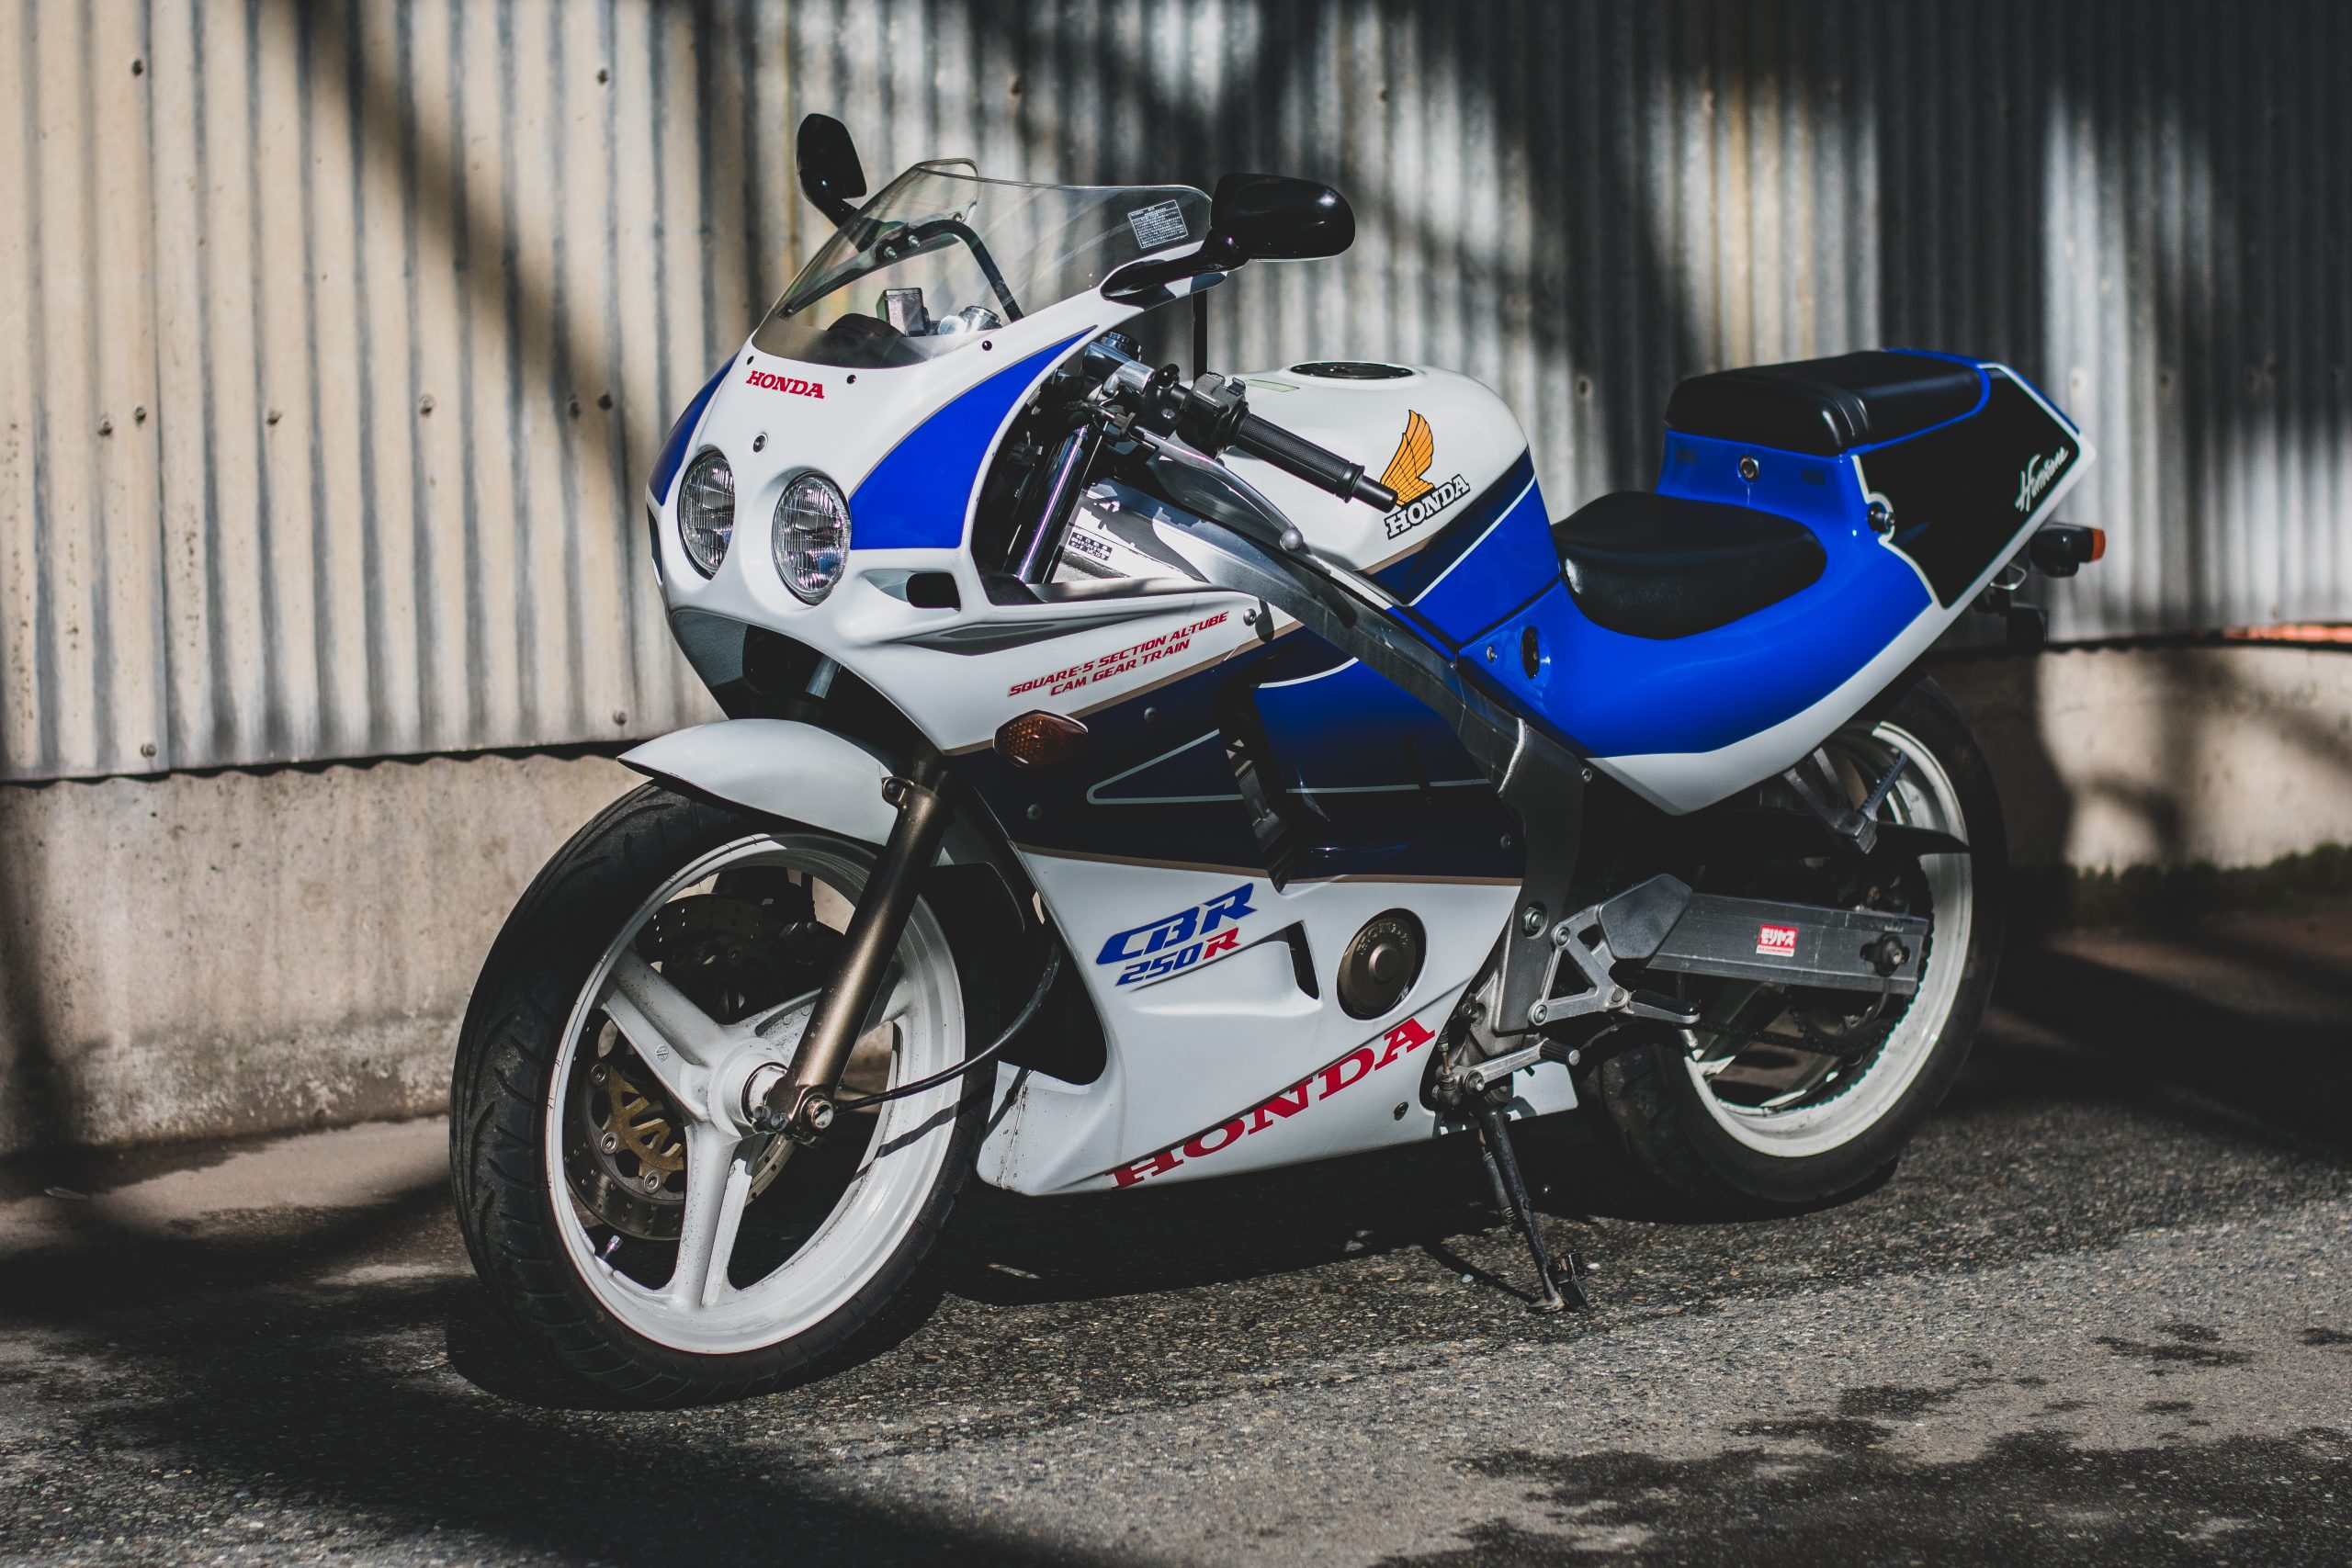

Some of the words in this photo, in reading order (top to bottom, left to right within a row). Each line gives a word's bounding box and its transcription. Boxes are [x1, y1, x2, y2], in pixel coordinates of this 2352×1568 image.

[746, 370, 824, 399] HONDA
[1385, 474, 1470, 539] HONDA
[1009, 660, 1094, 697] SQUARE-5
[1099, 635, 1168, 667] SECTION
[1050, 676, 1087, 696] CAM
[1091, 660, 1136, 682] GEAR
[1141, 639, 1191, 665] TRAIN
[1096, 883, 1257, 964] CBR
[1115, 928, 1239, 986] 250R
[1105, 1018, 1436, 1190] HONDA
